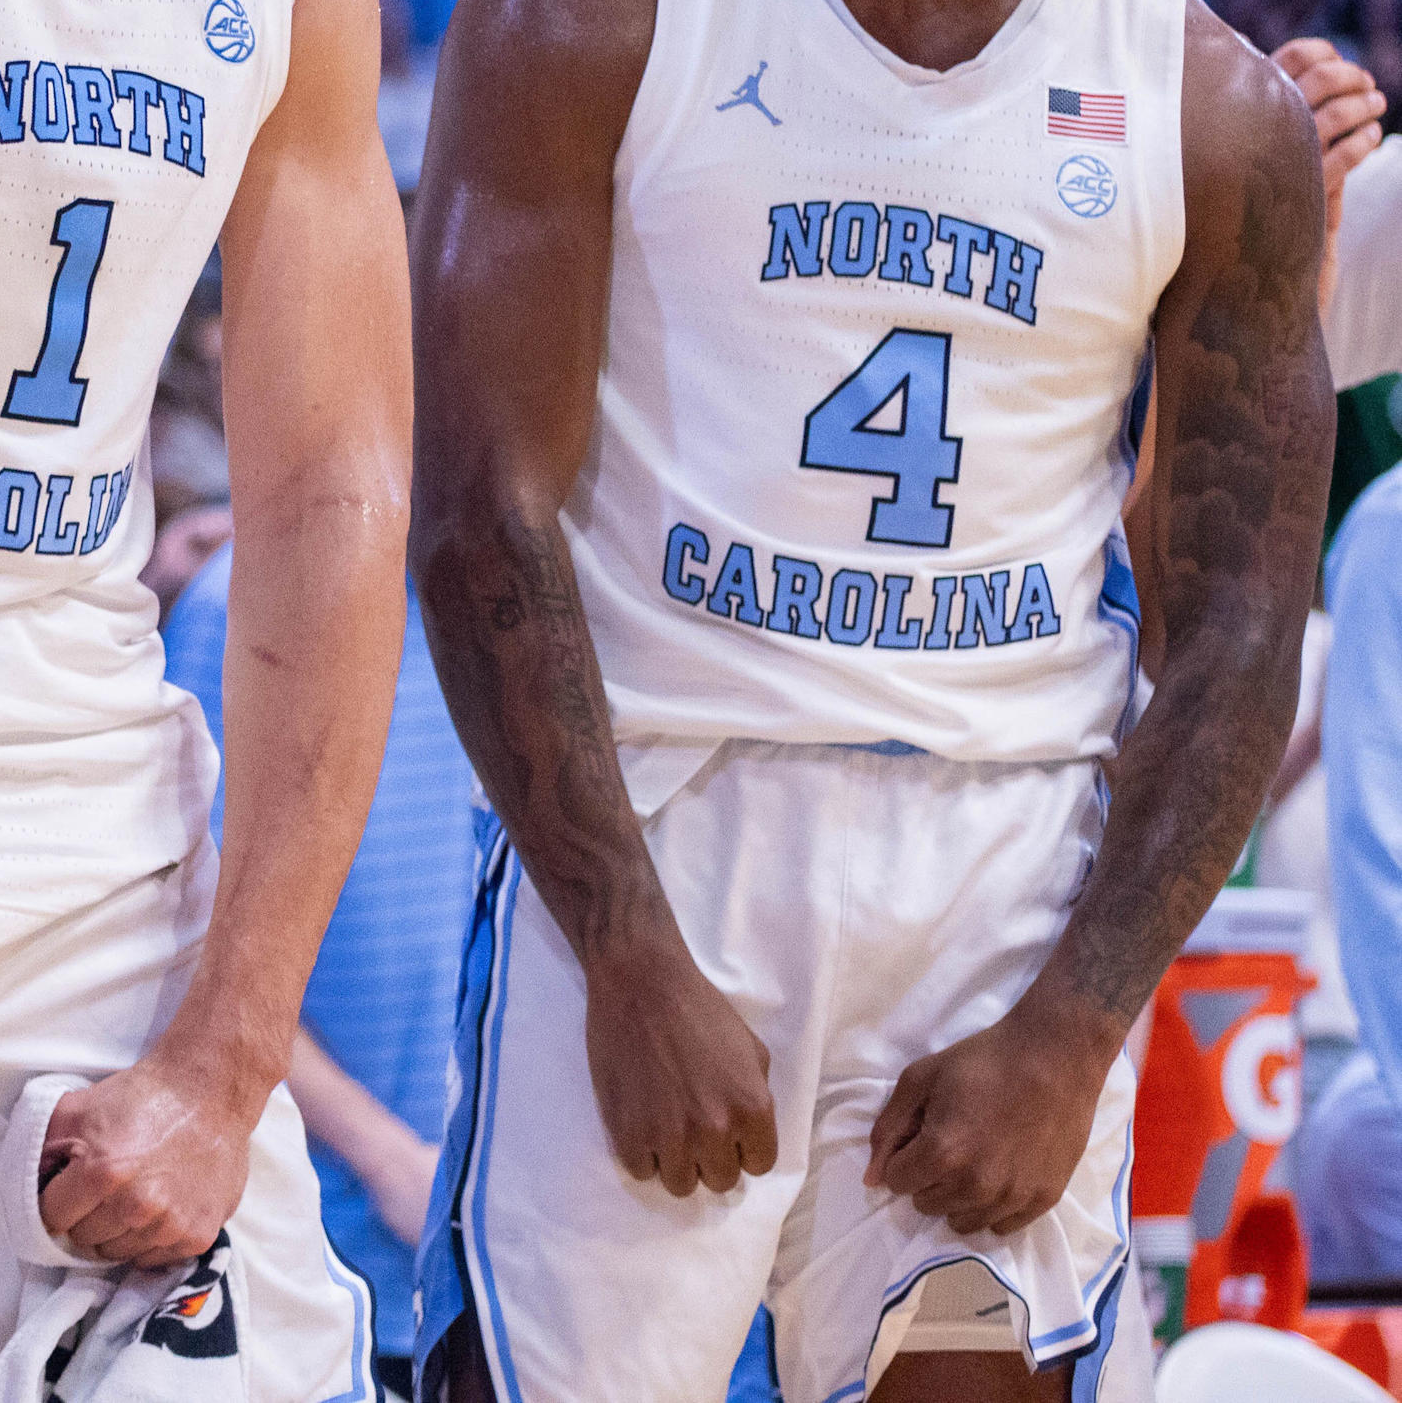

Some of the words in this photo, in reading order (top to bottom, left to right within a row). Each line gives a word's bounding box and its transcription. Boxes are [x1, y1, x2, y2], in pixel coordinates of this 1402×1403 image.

[211, 17, 249, 35] ACC
[1067, 175, 1112, 194] ACC
[1, 198, 113, 427] 1
[761, 201, 1044, 325] NORTH
[800, 327, 963, 548] 4
[662, 521, 1060, 650] CAROLINA
